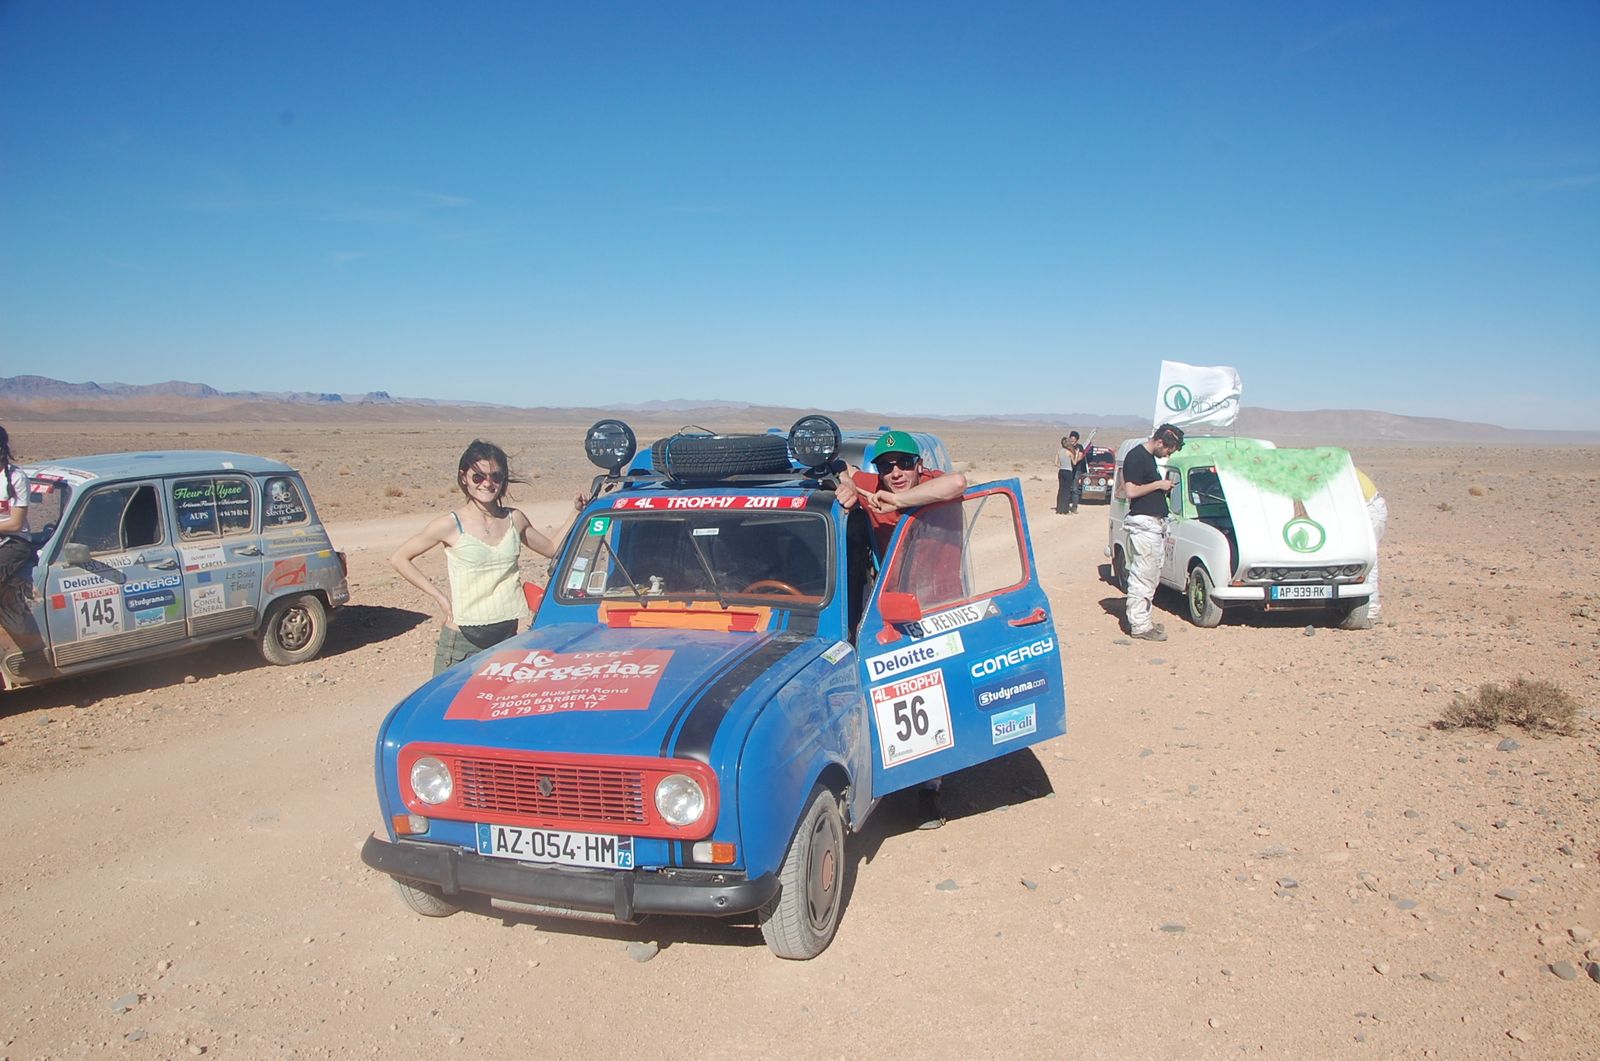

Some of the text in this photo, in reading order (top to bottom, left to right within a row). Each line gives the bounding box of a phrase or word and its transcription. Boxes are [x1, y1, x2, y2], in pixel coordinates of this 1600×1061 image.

[174, 488, 202, 499] Fleur
[634, 496, 780, 508] 4L TROPHY 2011
[189, 512, 209, 520] AUPS
[124, 576, 180, 593] CONERGY
[81, 598, 115, 627] 145
[907, 606, 979, 638] ESC RENNES
[521, 651, 554, 667] le
[971, 638, 1054, 678] CONERGY
[478, 660, 660, 682] Margériaz
[476, 692, 494, 701] 28
[496, 694, 518, 702] rue
[541, 688, 589, 697] Buisson
[593, 687, 629, 695] Rond
[874, 671, 941, 702] 4L TROPHY
[490, 694, 607, 710] 73000 BARBERAZ
[491, 701, 599, 718] 04 79 33 41 17
[893, 695, 929, 742] 56
[994, 716, 1033, 738] Sidi ali
[497, 827, 615, 863] AZ-054-HM
[618, 852, 632, 866] 73
